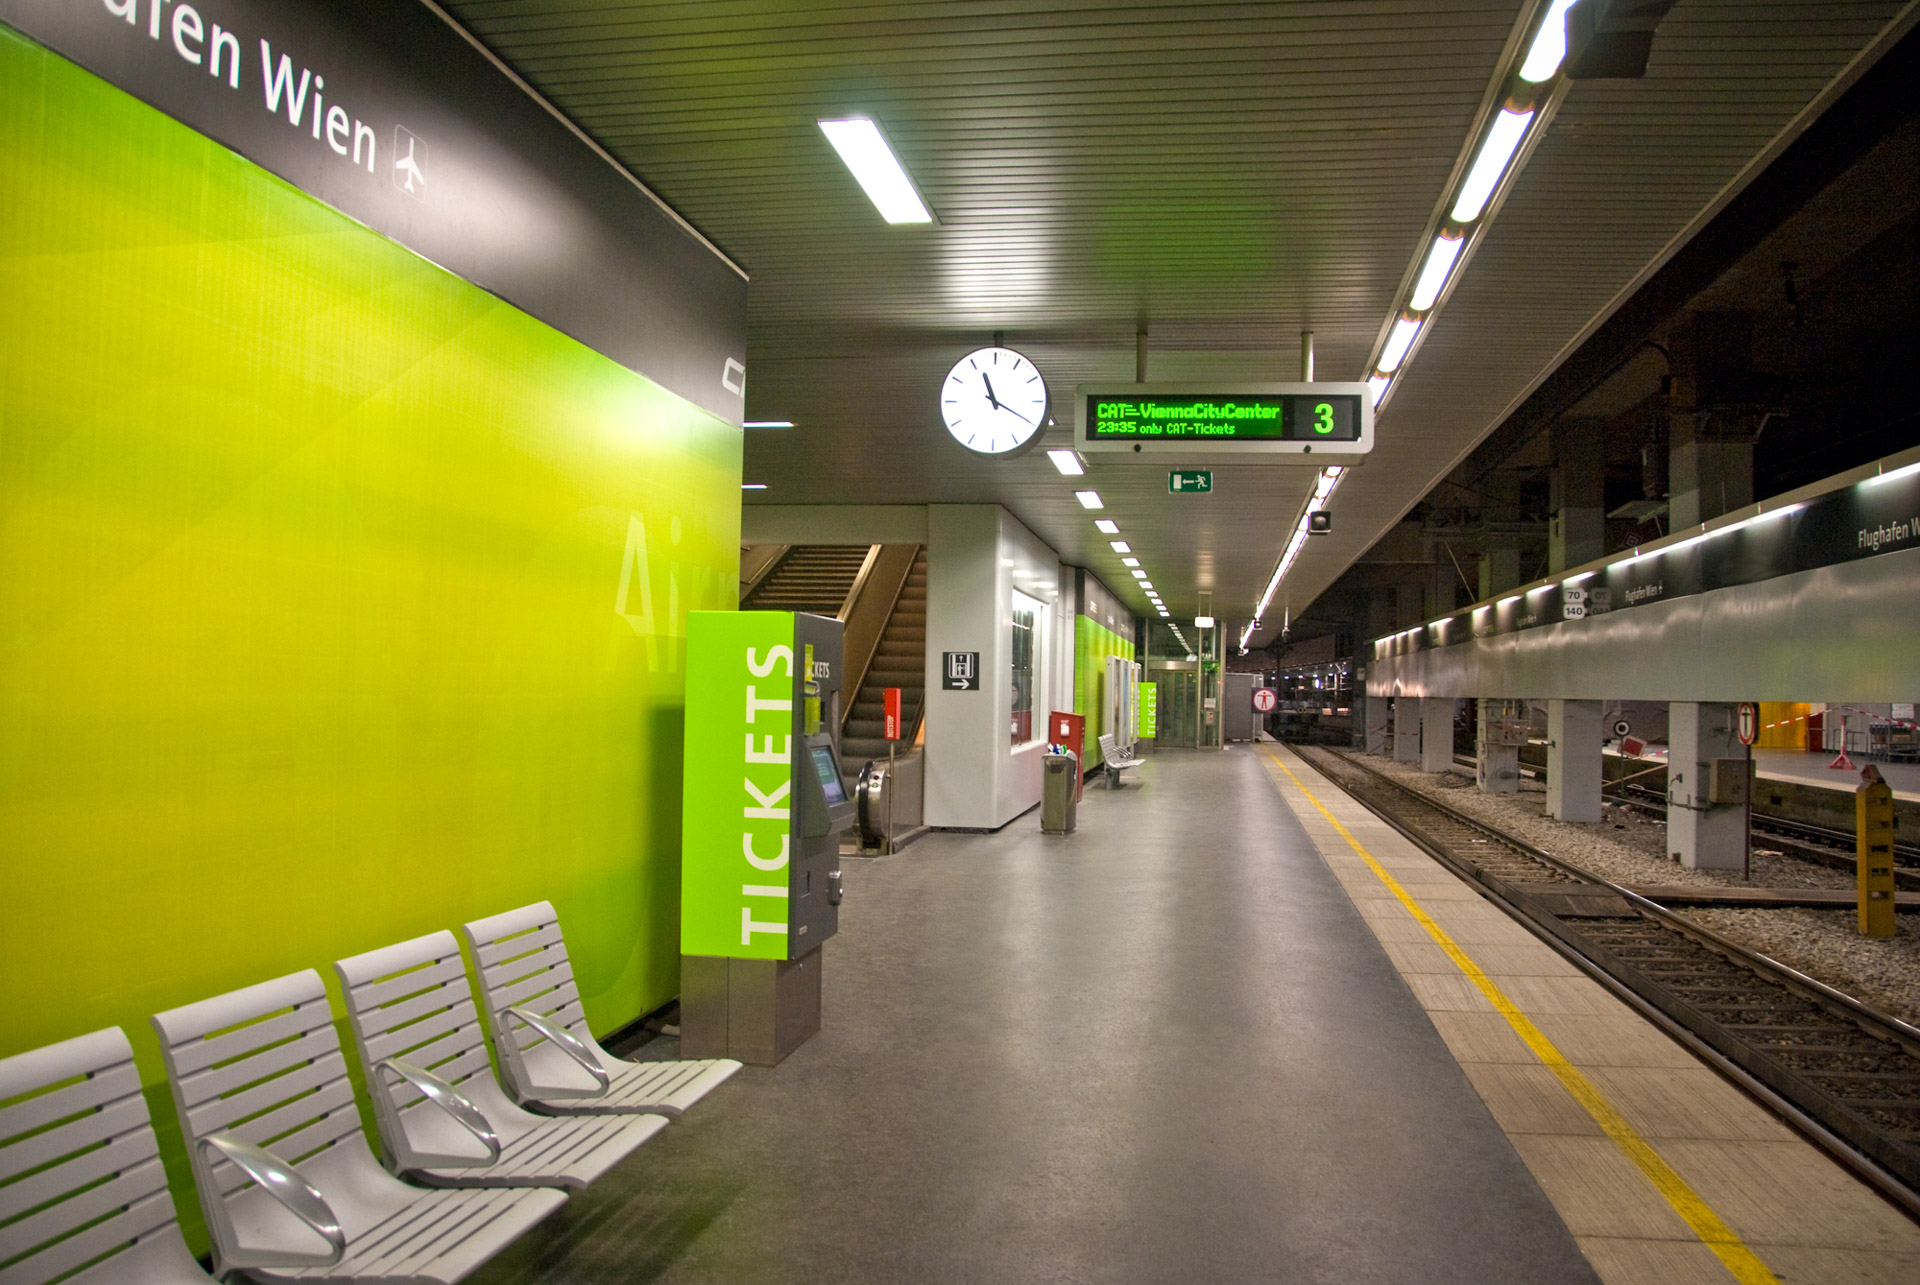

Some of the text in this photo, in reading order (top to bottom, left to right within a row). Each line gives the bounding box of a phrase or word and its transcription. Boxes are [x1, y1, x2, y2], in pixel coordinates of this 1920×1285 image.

[260, 38, 376, 173] Wien
[1097, 421, 1236, 435] 23:35 only CAT-Tickets
[1314, 403, 1334, 434] 3
[1858, 520, 1909, 551] Flughafen
[1565, 607, 1582, 615] 140
[1147, 688, 1156, 735] TICKETS
[741, 644, 793, 946] TICKETS
